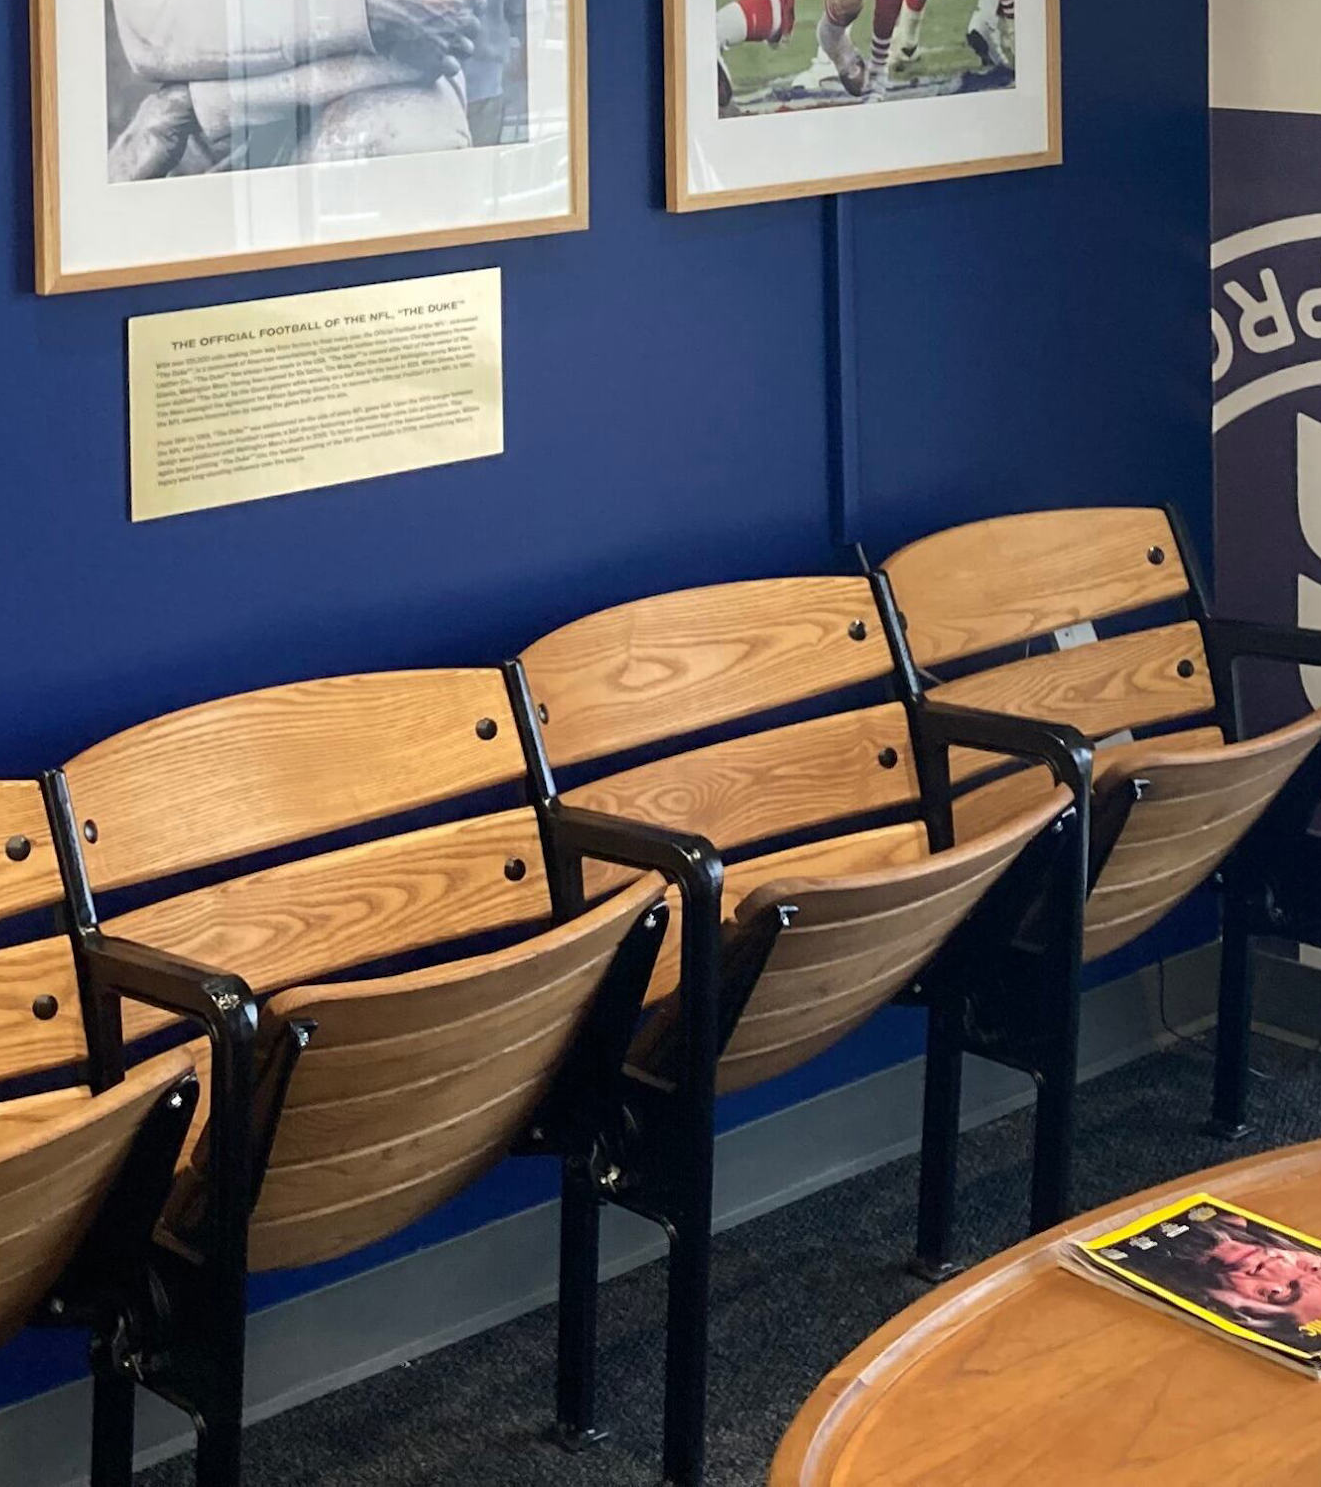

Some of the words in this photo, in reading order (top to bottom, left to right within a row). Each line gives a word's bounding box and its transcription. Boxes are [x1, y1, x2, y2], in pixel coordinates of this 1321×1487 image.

[171, 338, 196, 350] THE
[199, 331, 256, 346] OFFICIAL
[259, 321, 321, 338] FOOTBALL
[324, 317, 341, 328] OF
[344, 314, 366, 325] THE
